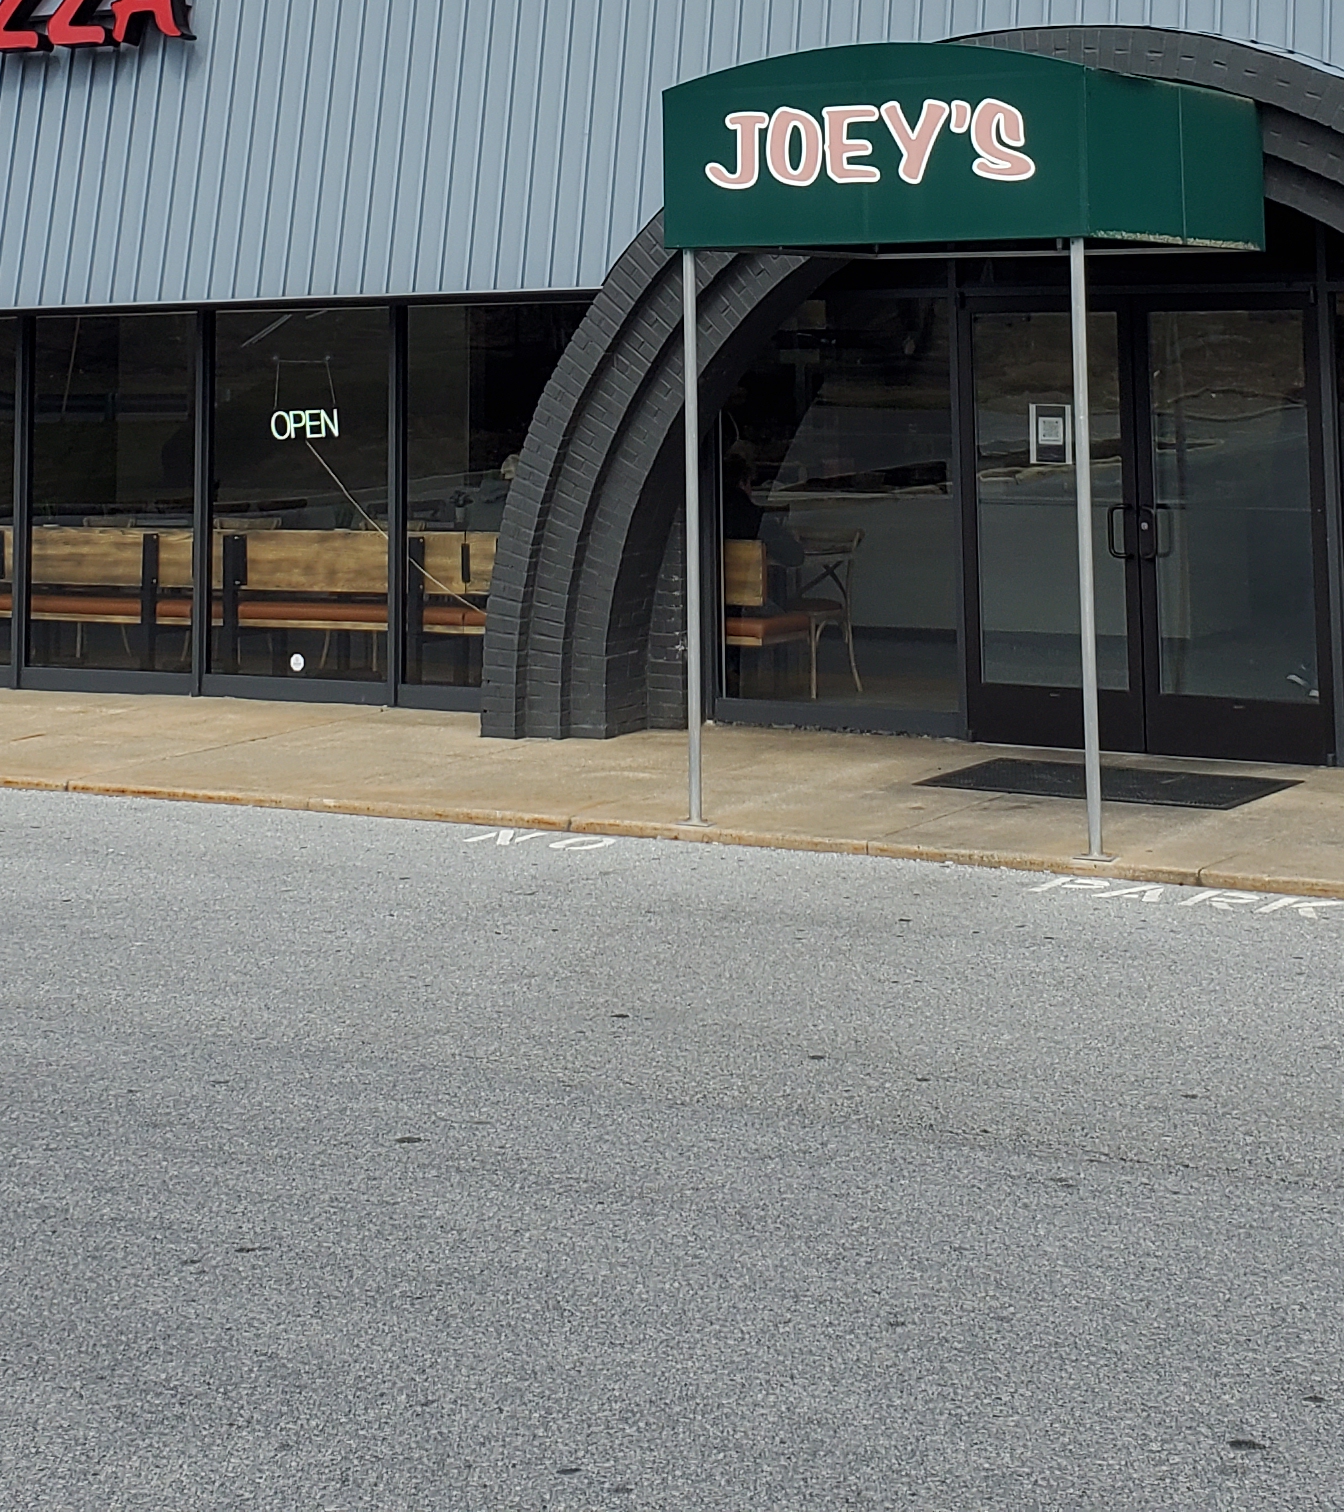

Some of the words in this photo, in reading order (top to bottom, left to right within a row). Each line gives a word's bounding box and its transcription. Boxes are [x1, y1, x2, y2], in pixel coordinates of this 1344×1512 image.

[705, 97, 1036, 190] JOEY'S
[270, 408, 340, 440] OPEN
[462, 829, 617, 851] NO
